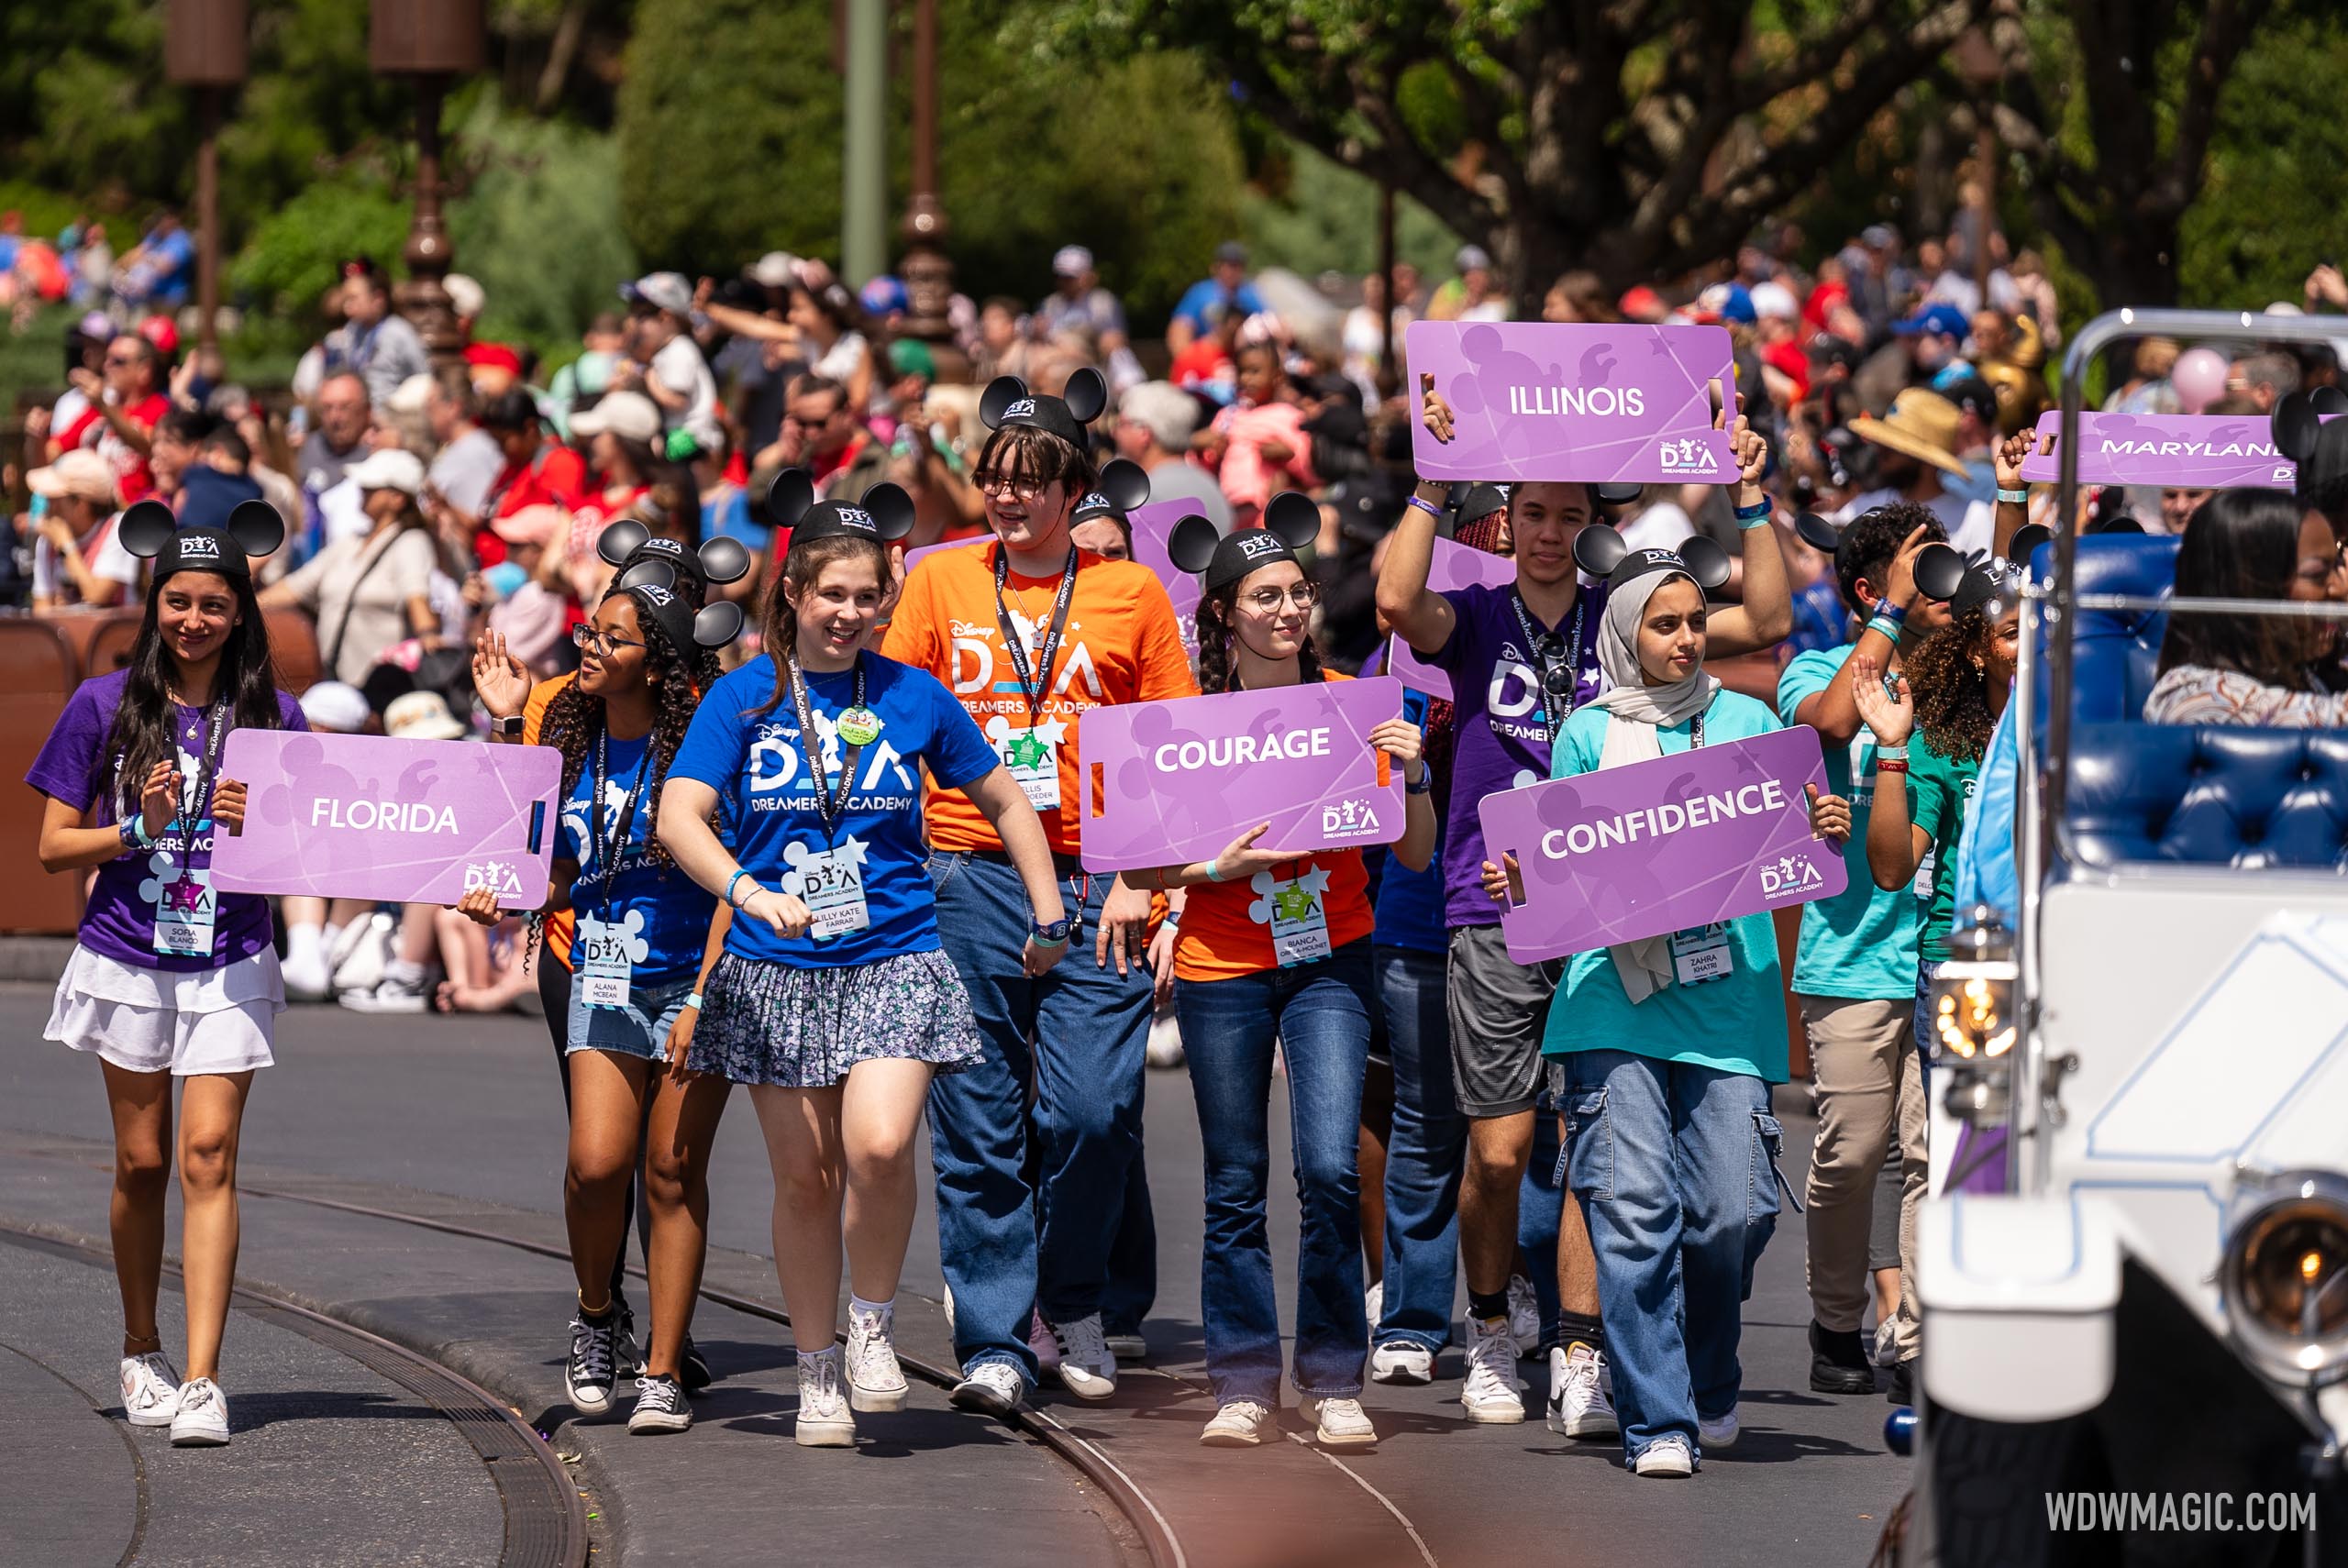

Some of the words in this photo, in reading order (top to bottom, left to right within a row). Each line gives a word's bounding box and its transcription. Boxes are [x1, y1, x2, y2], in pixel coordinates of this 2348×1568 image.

[1510, 386, 1645, 416] ILLINOIS
[949, 619, 995, 639] Disney
[962, 701, 1024, 713] REAMERS
[756, 723, 800, 743] Disney
[1490, 720, 1548, 742] DREAME
[1155, 727, 1330, 773] COURAGE
[751, 798, 819, 812] DREAMER
[312, 798, 459, 834] FLORIDA
[1541, 779, 1786, 859] CONFIDENCE
[808, 892, 834, 901] DREAMERS
[835, 887, 858, 896] ACADEMY
[816, 911, 837, 922] LILLY
[839, 907, 860, 917] KATE
[825, 917, 854, 928] FARRAR
[1288, 936, 1318, 947] BIANCA
[1690, 955, 1717, 966] ZAHRA
[1693, 963, 1718, 973] KHATRI
